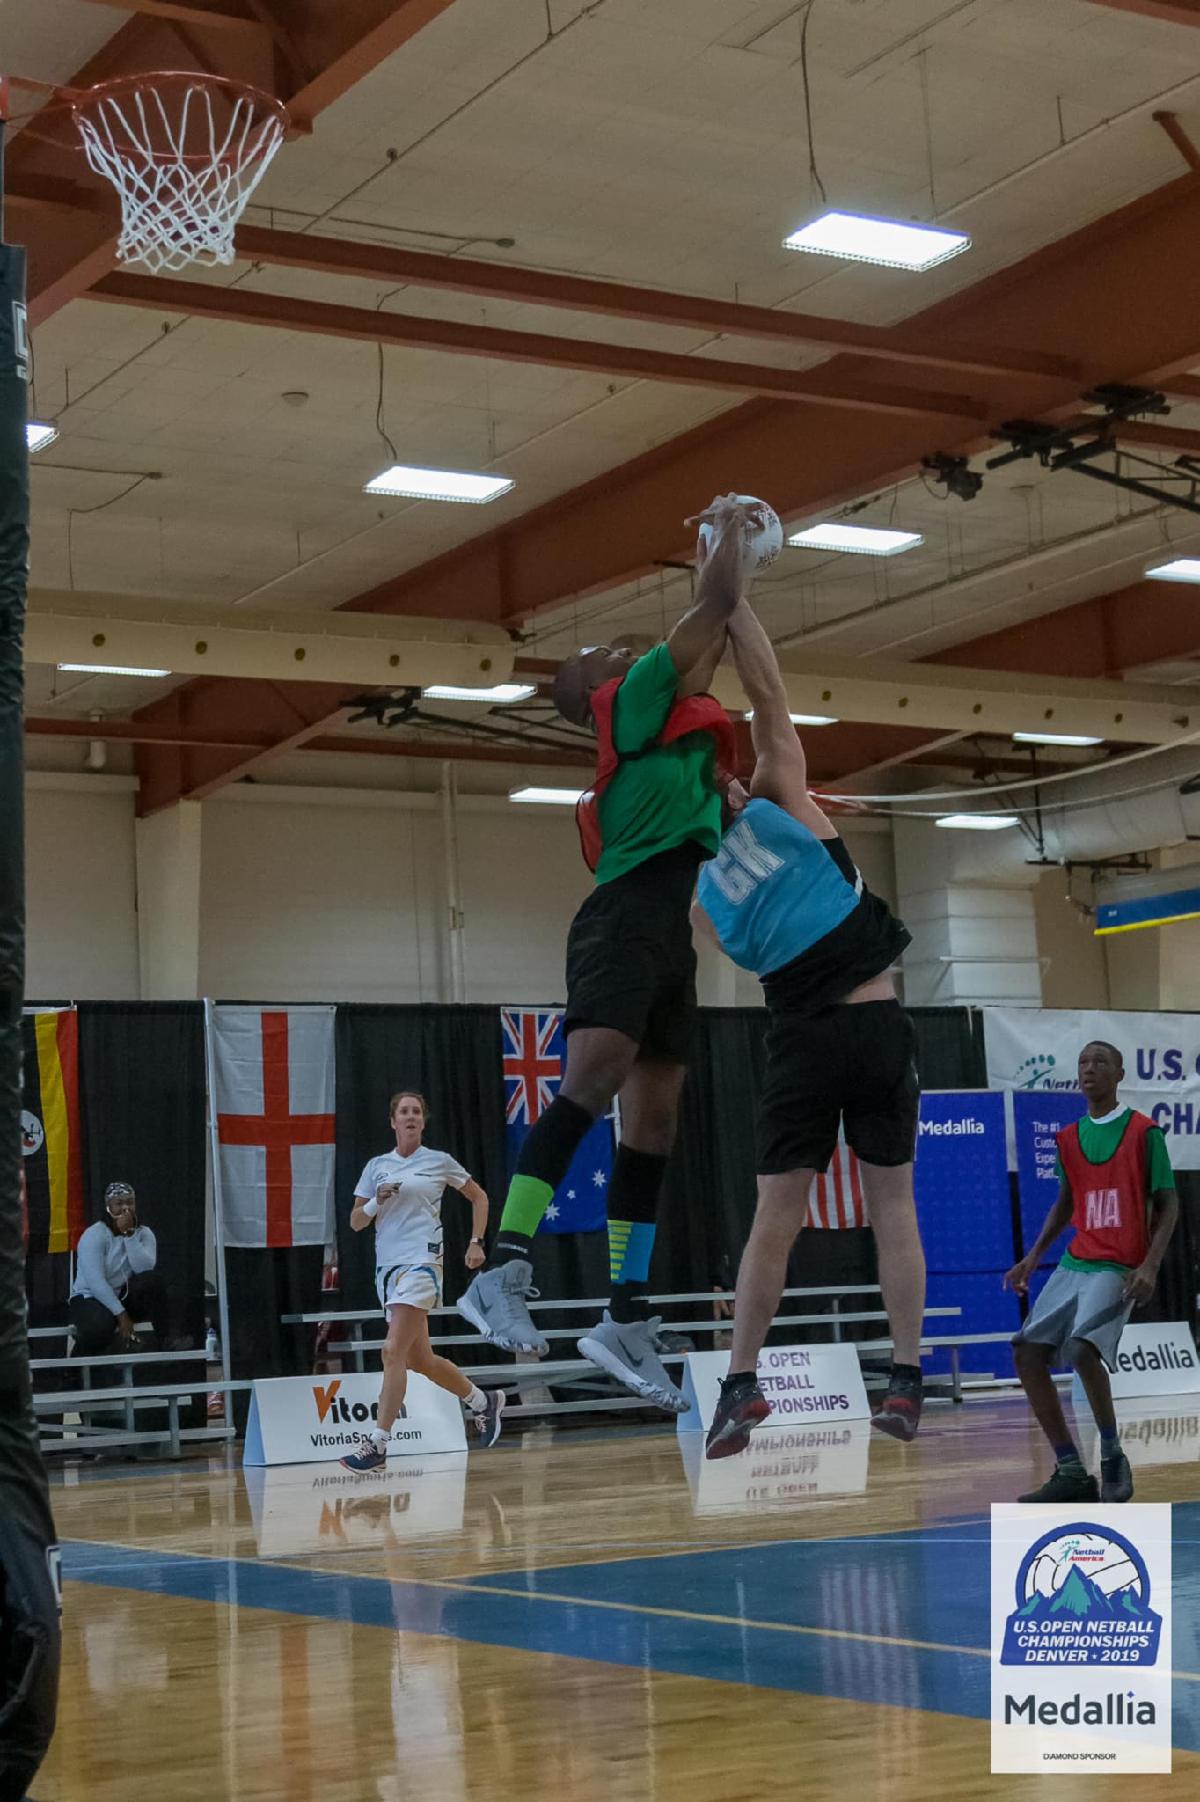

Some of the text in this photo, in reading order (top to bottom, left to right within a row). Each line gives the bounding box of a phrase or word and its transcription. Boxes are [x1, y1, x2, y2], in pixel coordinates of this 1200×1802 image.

[708, 819, 786, 906] GK
[1136, 1048, 1187, 1081] U.S.
[918, 1117, 985, 1136] Medallia
[1032, 1121, 1048, 1133] The
[1151, 1102, 1200, 1135] CH
[1035, 1152, 1056, 1166] Expe
[769, 1351, 811, 1368] OPEN
[1115, 1341, 1195, 1373] edallia
[758, 1374, 815, 1392] ETBALL
[767, 1394, 850, 1414] PIONSHIPS
